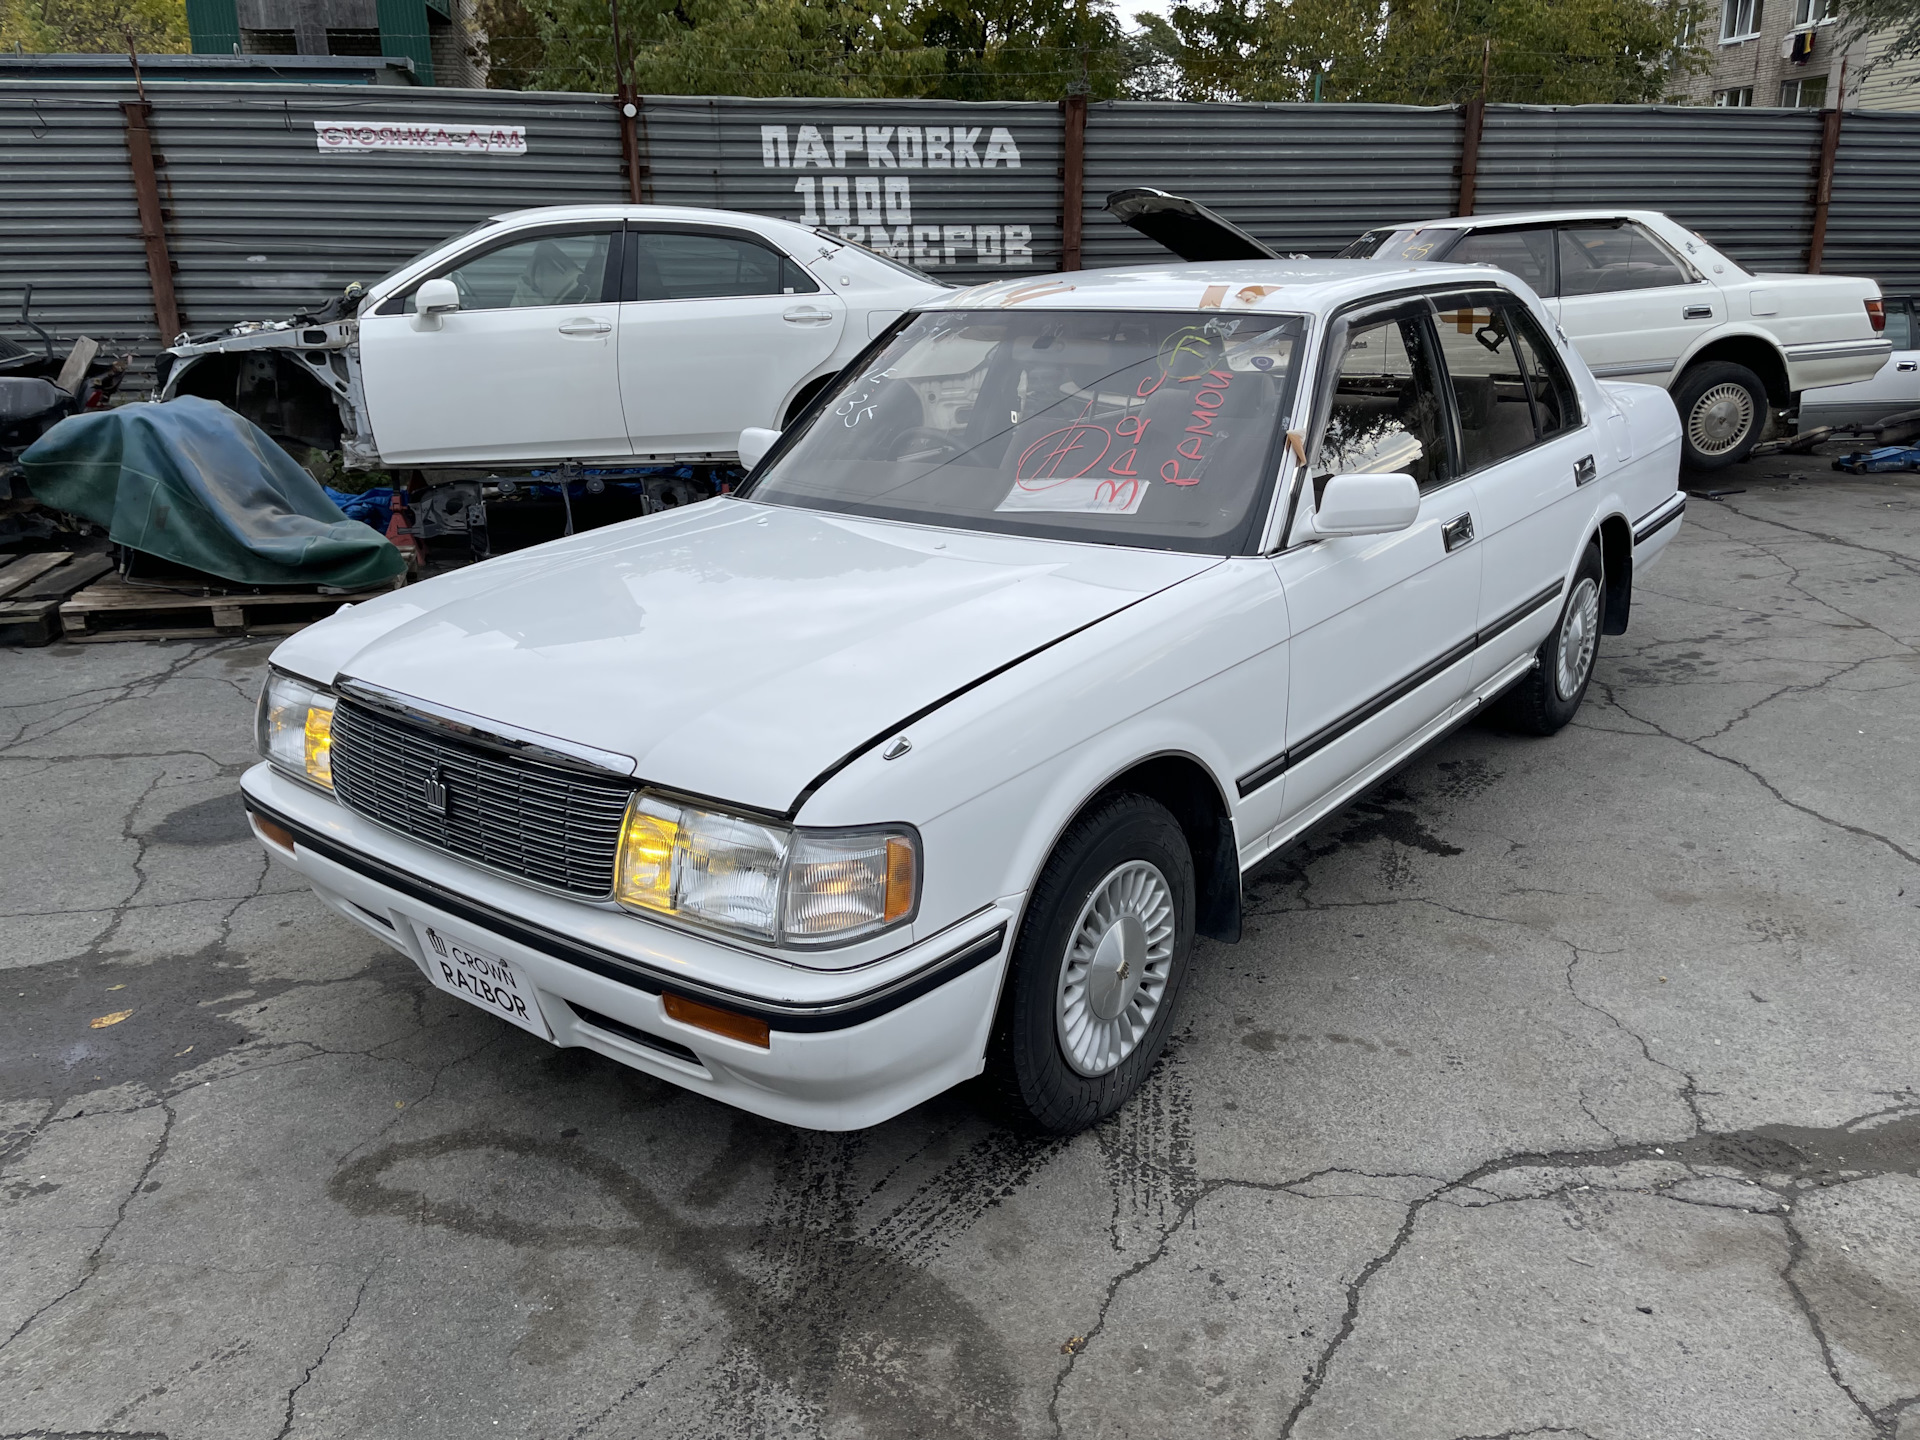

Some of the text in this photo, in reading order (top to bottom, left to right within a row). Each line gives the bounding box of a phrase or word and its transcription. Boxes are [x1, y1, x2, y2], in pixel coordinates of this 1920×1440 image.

[322, 127, 520, 151] СТОЯНКА А/М
[760, 125, 1022, 169] ПАРКОВКА
[794, 176, 912, 226] 1000
[439, 960, 532, 1021] RAZBOR
[452, 947, 518, 990] CROWN
